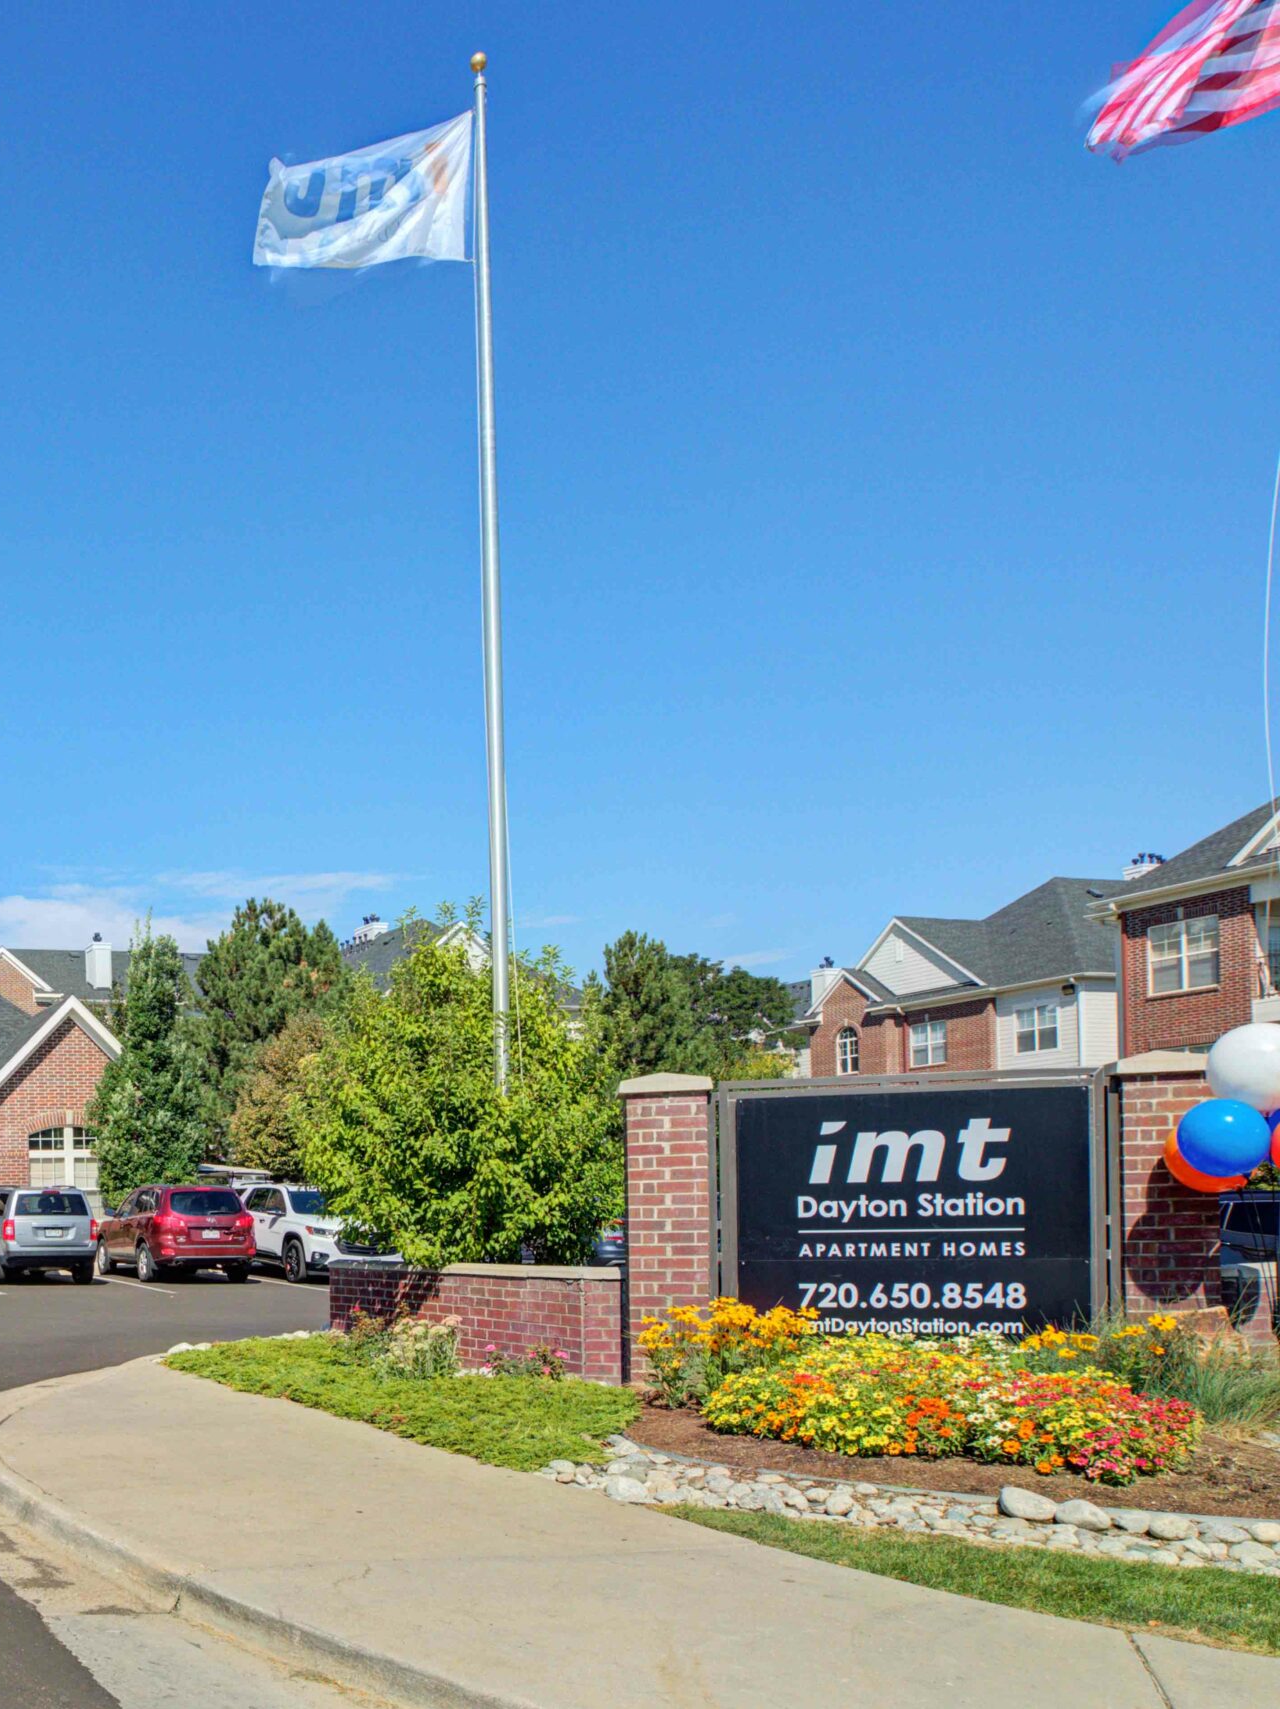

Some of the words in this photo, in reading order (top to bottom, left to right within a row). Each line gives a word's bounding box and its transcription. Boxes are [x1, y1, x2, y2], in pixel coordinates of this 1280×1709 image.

[809, 1118, 1011, 1184] imt
[797, 1194, 908, 1223] Dayton
[917, 1192, 1026, 1217] Station
[798, 1243, 932, 1258] APARTMENT
[942, 1241, 1026, 1257] HOMES
[798, 1282, 1027, 1309] 720.650.8548
[801, 1316, 1024, 1336] mtDaytonStation.com
